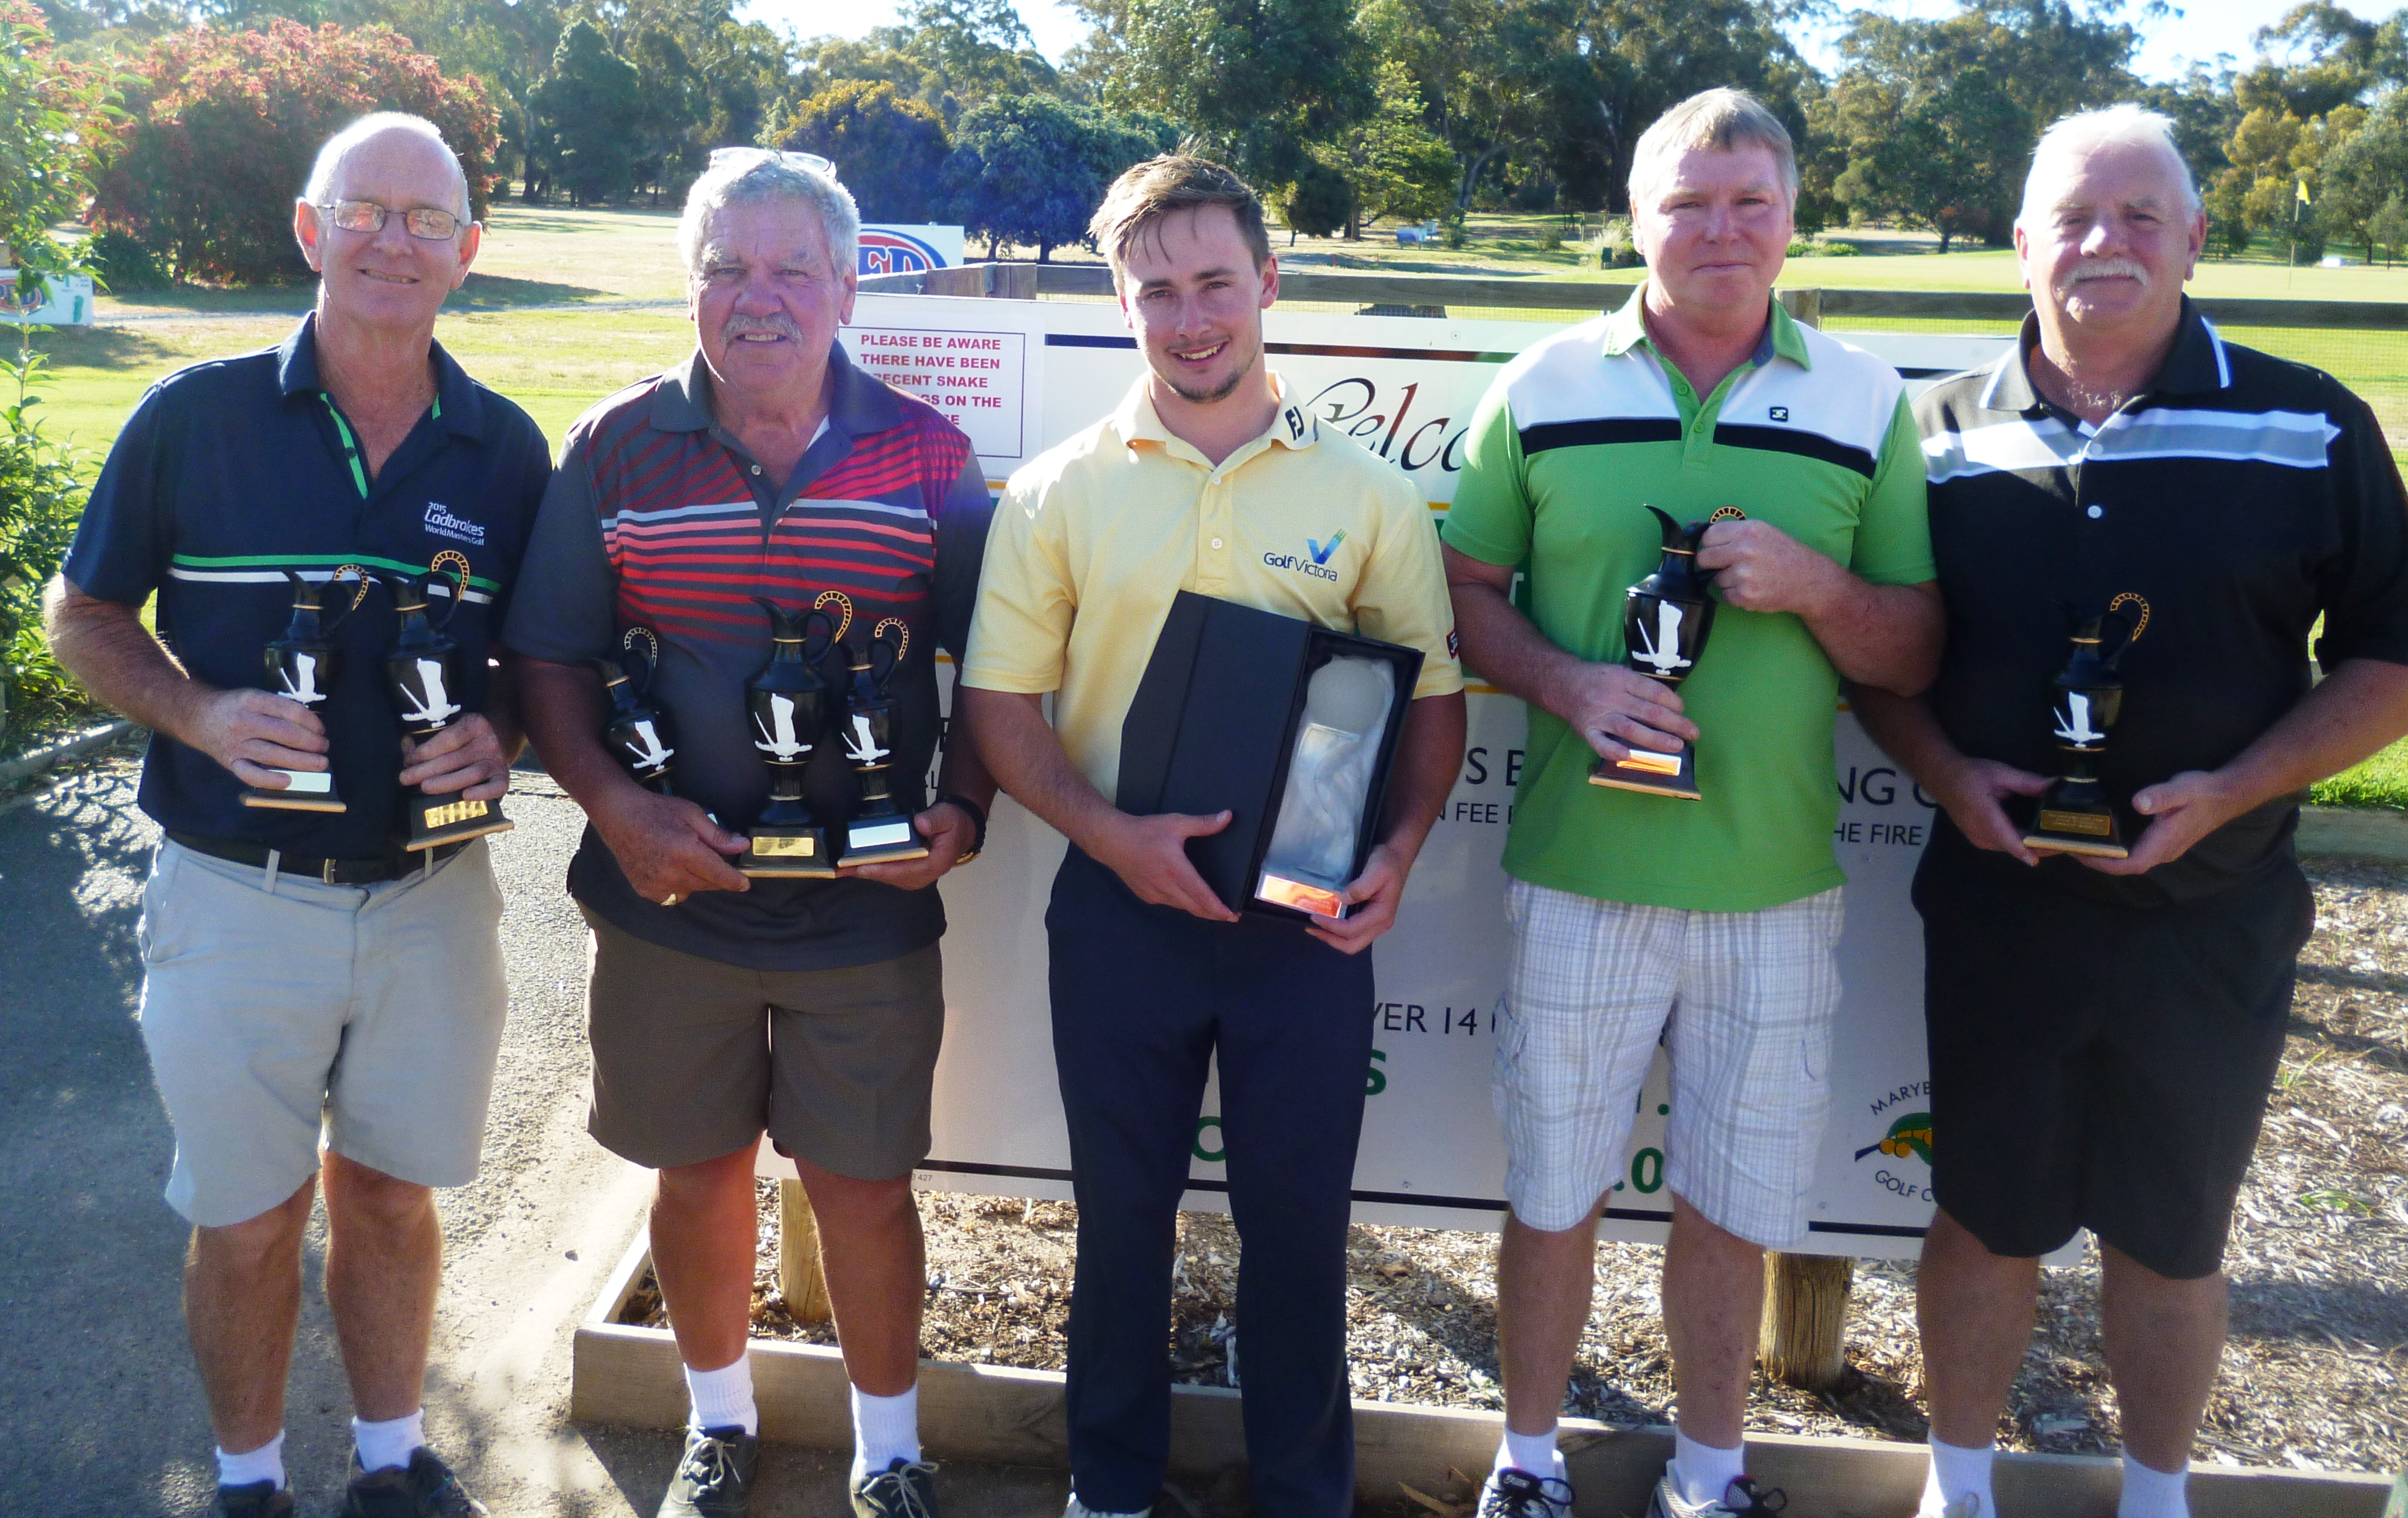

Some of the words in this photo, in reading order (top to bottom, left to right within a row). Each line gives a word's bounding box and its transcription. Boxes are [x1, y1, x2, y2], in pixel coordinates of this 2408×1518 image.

[861, 335, 918, 347] PLEASE
[923, 337, 942, 348] BE
[947, 337, 1001, 350] AWARE
[860, 353, 910, 366] THERE
[915, 356, 955, 368] HAVE
[960, 357, 1000, 369] BEEN
[937, 375, 988, 388] SNAKE
[945, 395, 967, 407] ON
[972, 396, 1002, 408] THE
[428, 502, 447, 514] 2015
[424, 509, 485, 537] Ladbrokes
[1456, 802, 1499, 824] FEE
[1870, 823, 1923, 847] FIRE
[1444, 1007, 1477, 1036] 14
[918, 1174, 933, 1182] 427
[1876, 1170, 1918, 1197] GOLF
